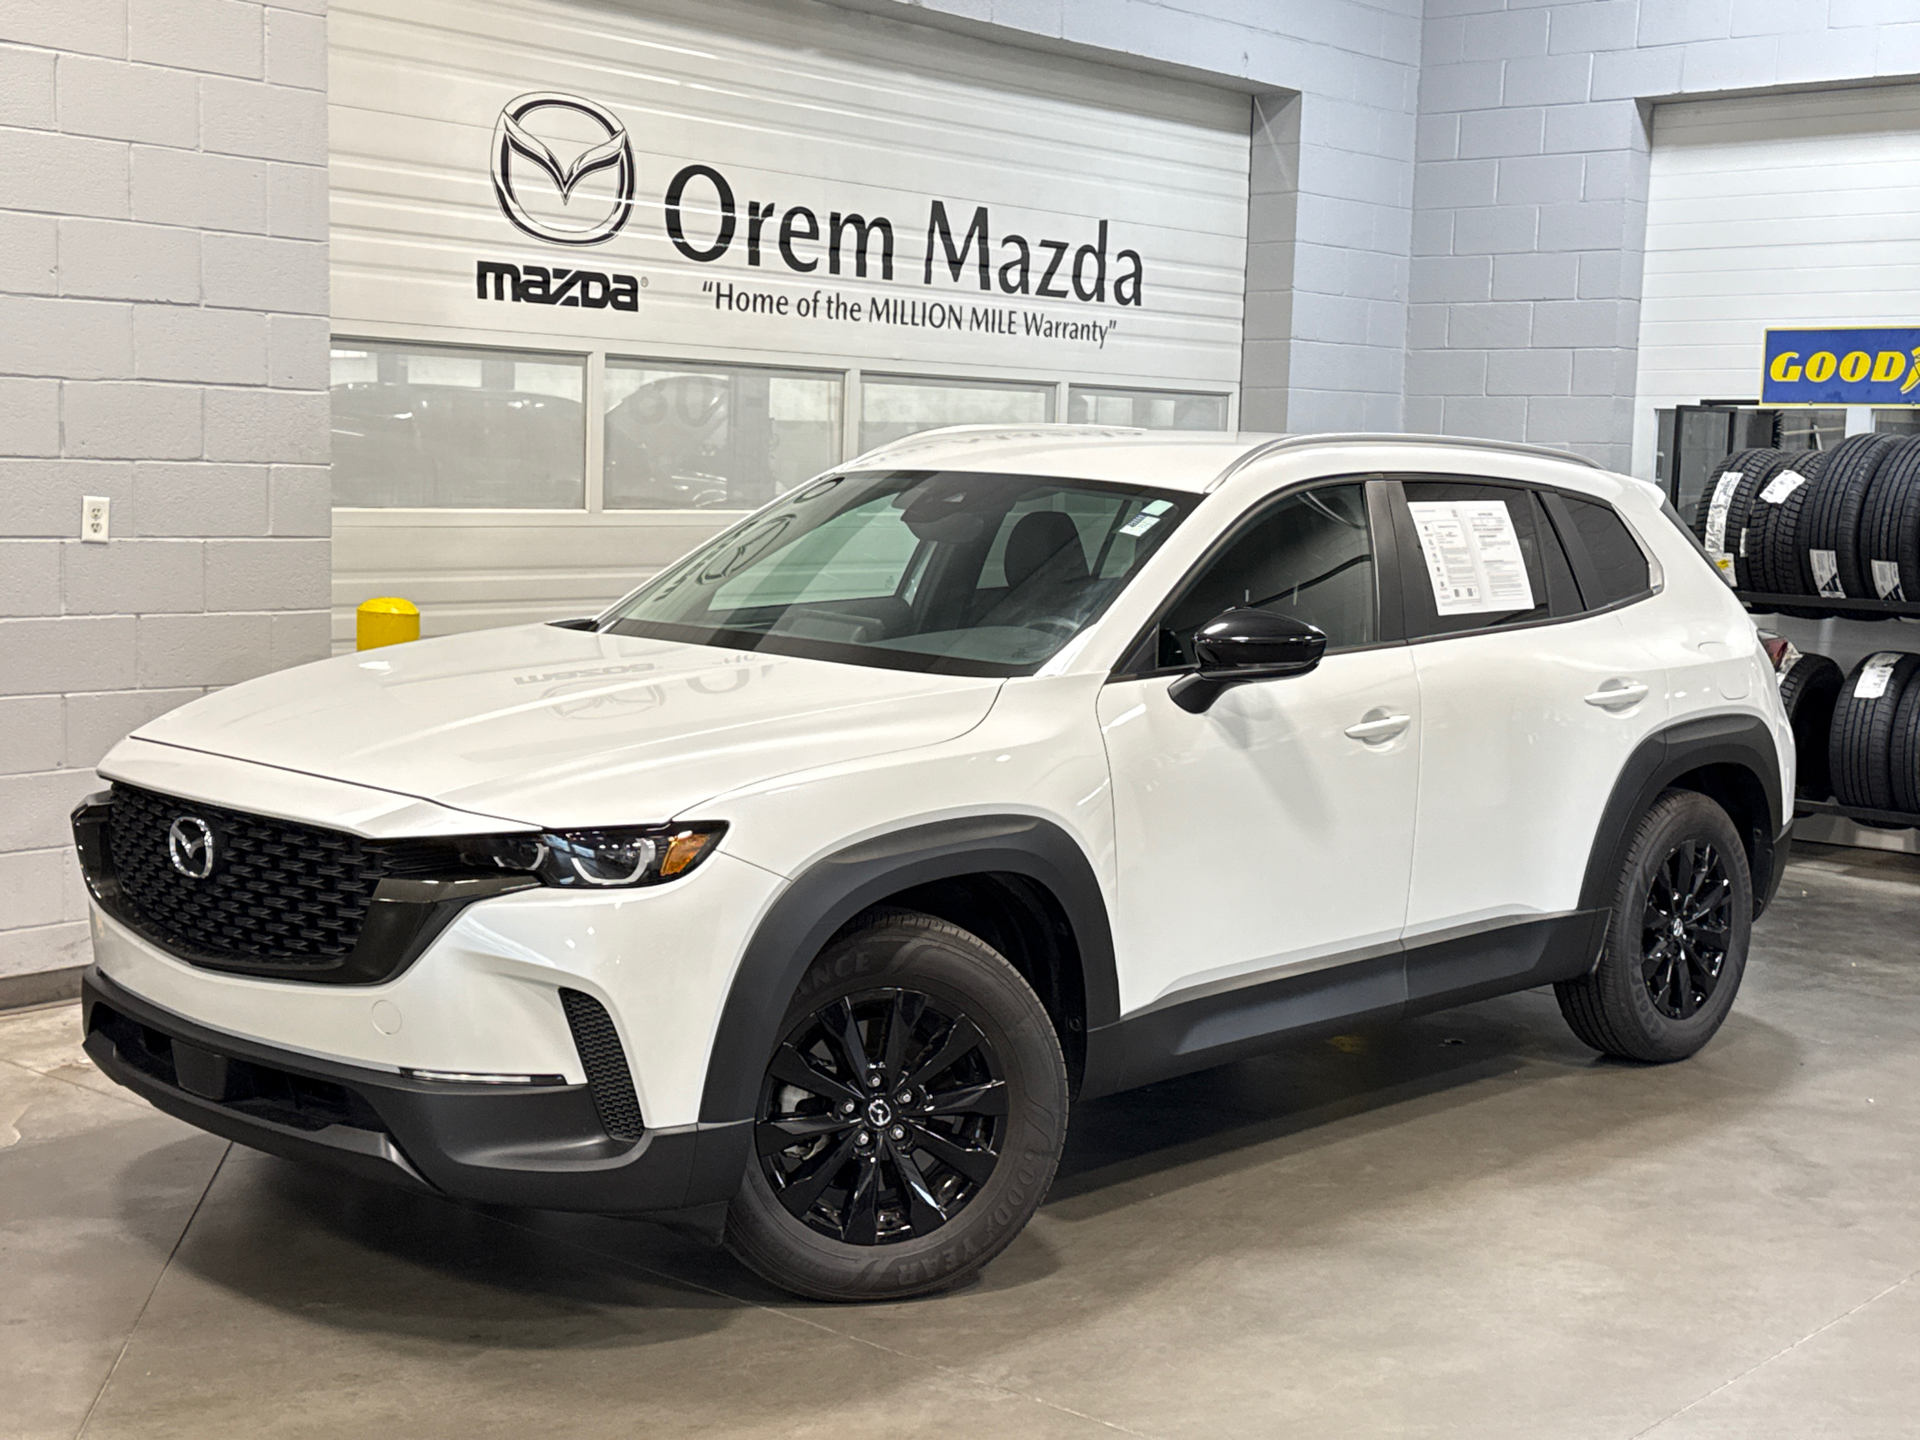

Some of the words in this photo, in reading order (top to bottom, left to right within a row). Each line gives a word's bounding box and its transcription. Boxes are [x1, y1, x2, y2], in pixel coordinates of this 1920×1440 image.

[664, 164, 894, 281] Orem
[923, 199, 1143, 307] Mazda
[476, 260, 640, 312] mazda
[796, 290, 822, 318] of
[826, 292, 863, 322] the
[868, 297, 963, 331] MILLION
[969, 306, 1018, 335] MILE
